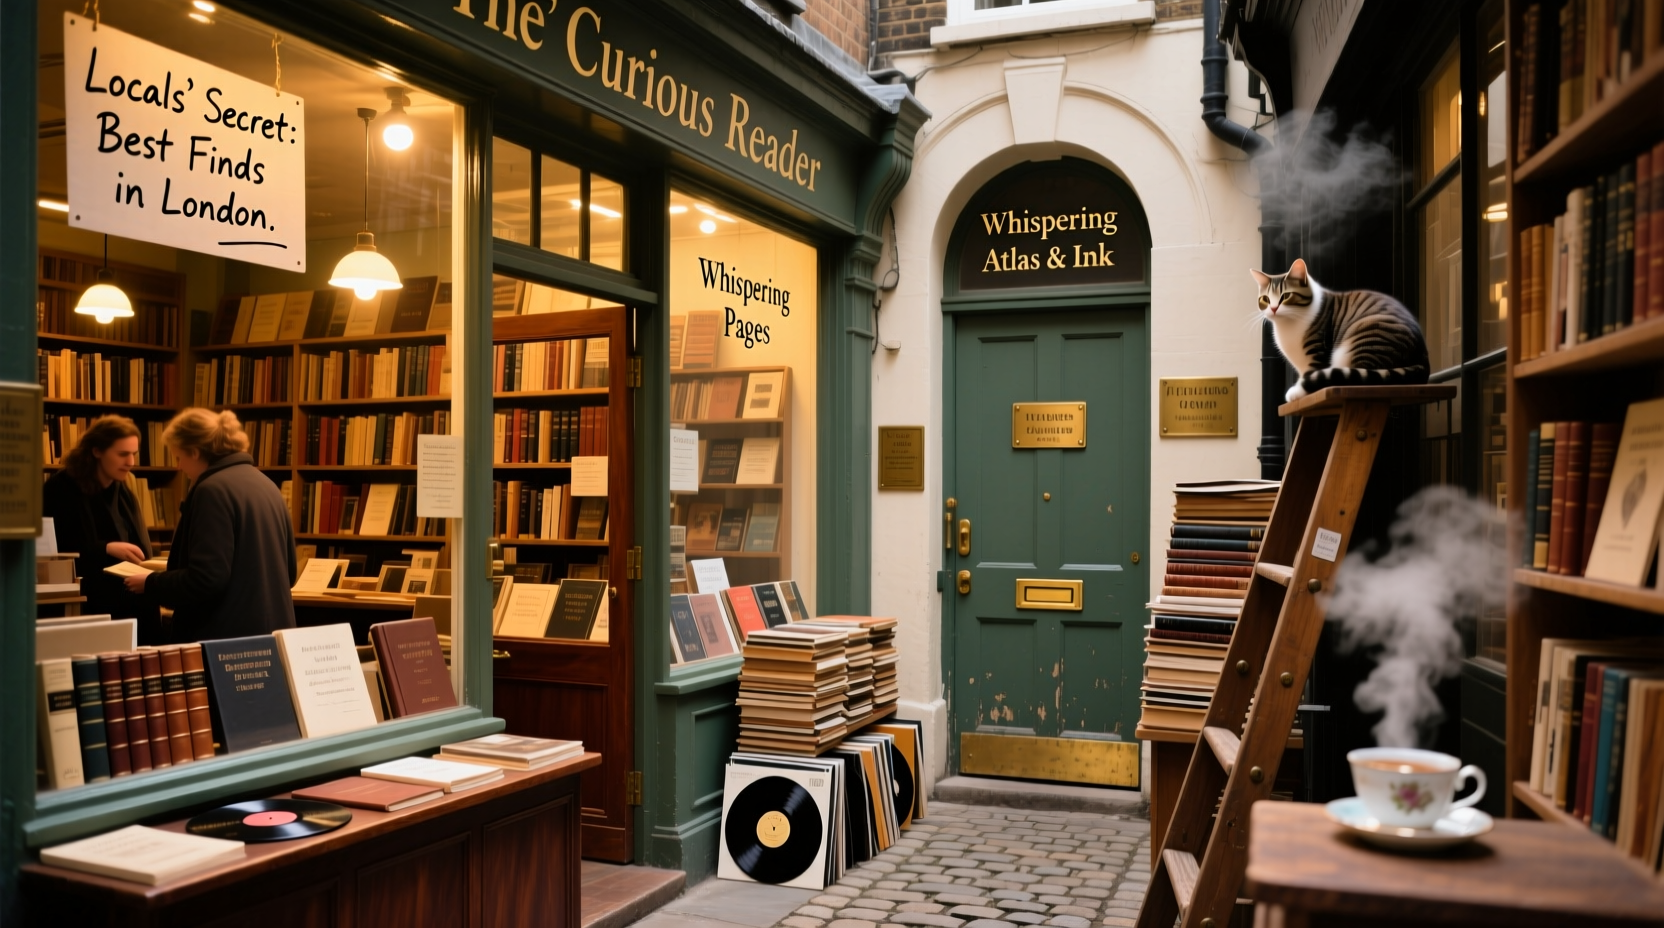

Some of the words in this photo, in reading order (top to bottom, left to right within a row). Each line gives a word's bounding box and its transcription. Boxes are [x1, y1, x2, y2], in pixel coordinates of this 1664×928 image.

[85, 47, 194, 114] Locals'
[203, 87, 297, 144] Secret:
[566, 6, 715, 137] Curious
[724, 93, 821, 192] Reader
[97, 111, 174, 162] Best
[189, 136, 265, 185] Finds
[115, 172, 145, 208] in
[161, 178, 275, 232] London.
[980, 206, 1120, 240] Whispering
[698, 257, 791, 318] Whispering
[981, 246, 1041, 273] Atlas
[1046, 246, 1067, 270] &
[1073, 243, 1115, 268] Ink
[724, 306, 771, 349] Pages
